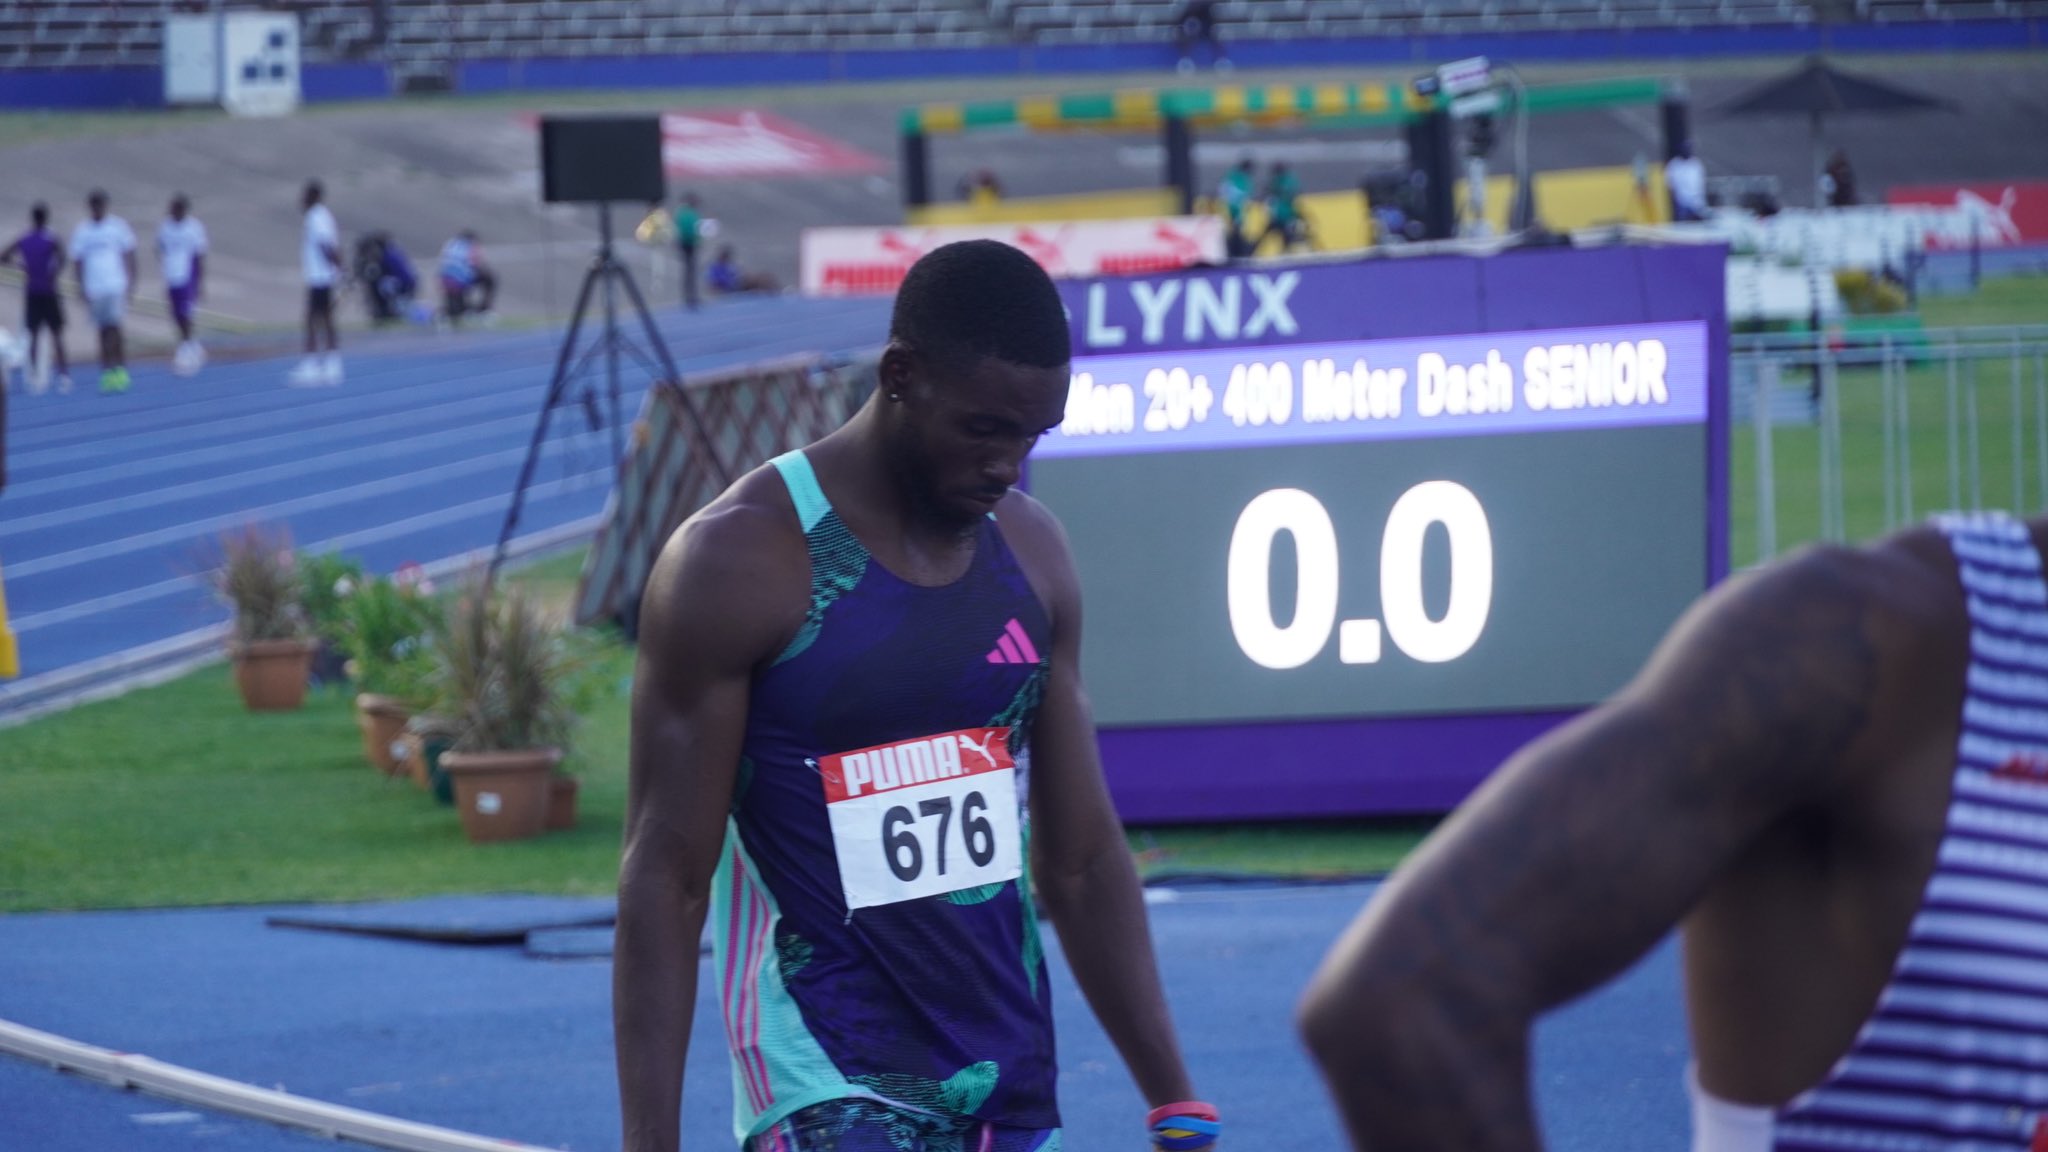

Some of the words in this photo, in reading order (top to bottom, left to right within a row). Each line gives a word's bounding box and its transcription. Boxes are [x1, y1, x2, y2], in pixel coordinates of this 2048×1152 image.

[1086, 270, 1301, 347] LYNX
[1061, 372, 1134, 436] Men
[1144, 366, 1214, 431] 20+
[1223, 360, 1293, 426] 400
[1302, 357, 1407, 423] Meter
[1417, 348, 1513, 417] Dash
[1523, 339, 1669, 412] SENIOR
[1227, 480, 1493, 669] 0.0
[841, 735, 963, 796] PUMA
[882, 791, 996, 882] 676
